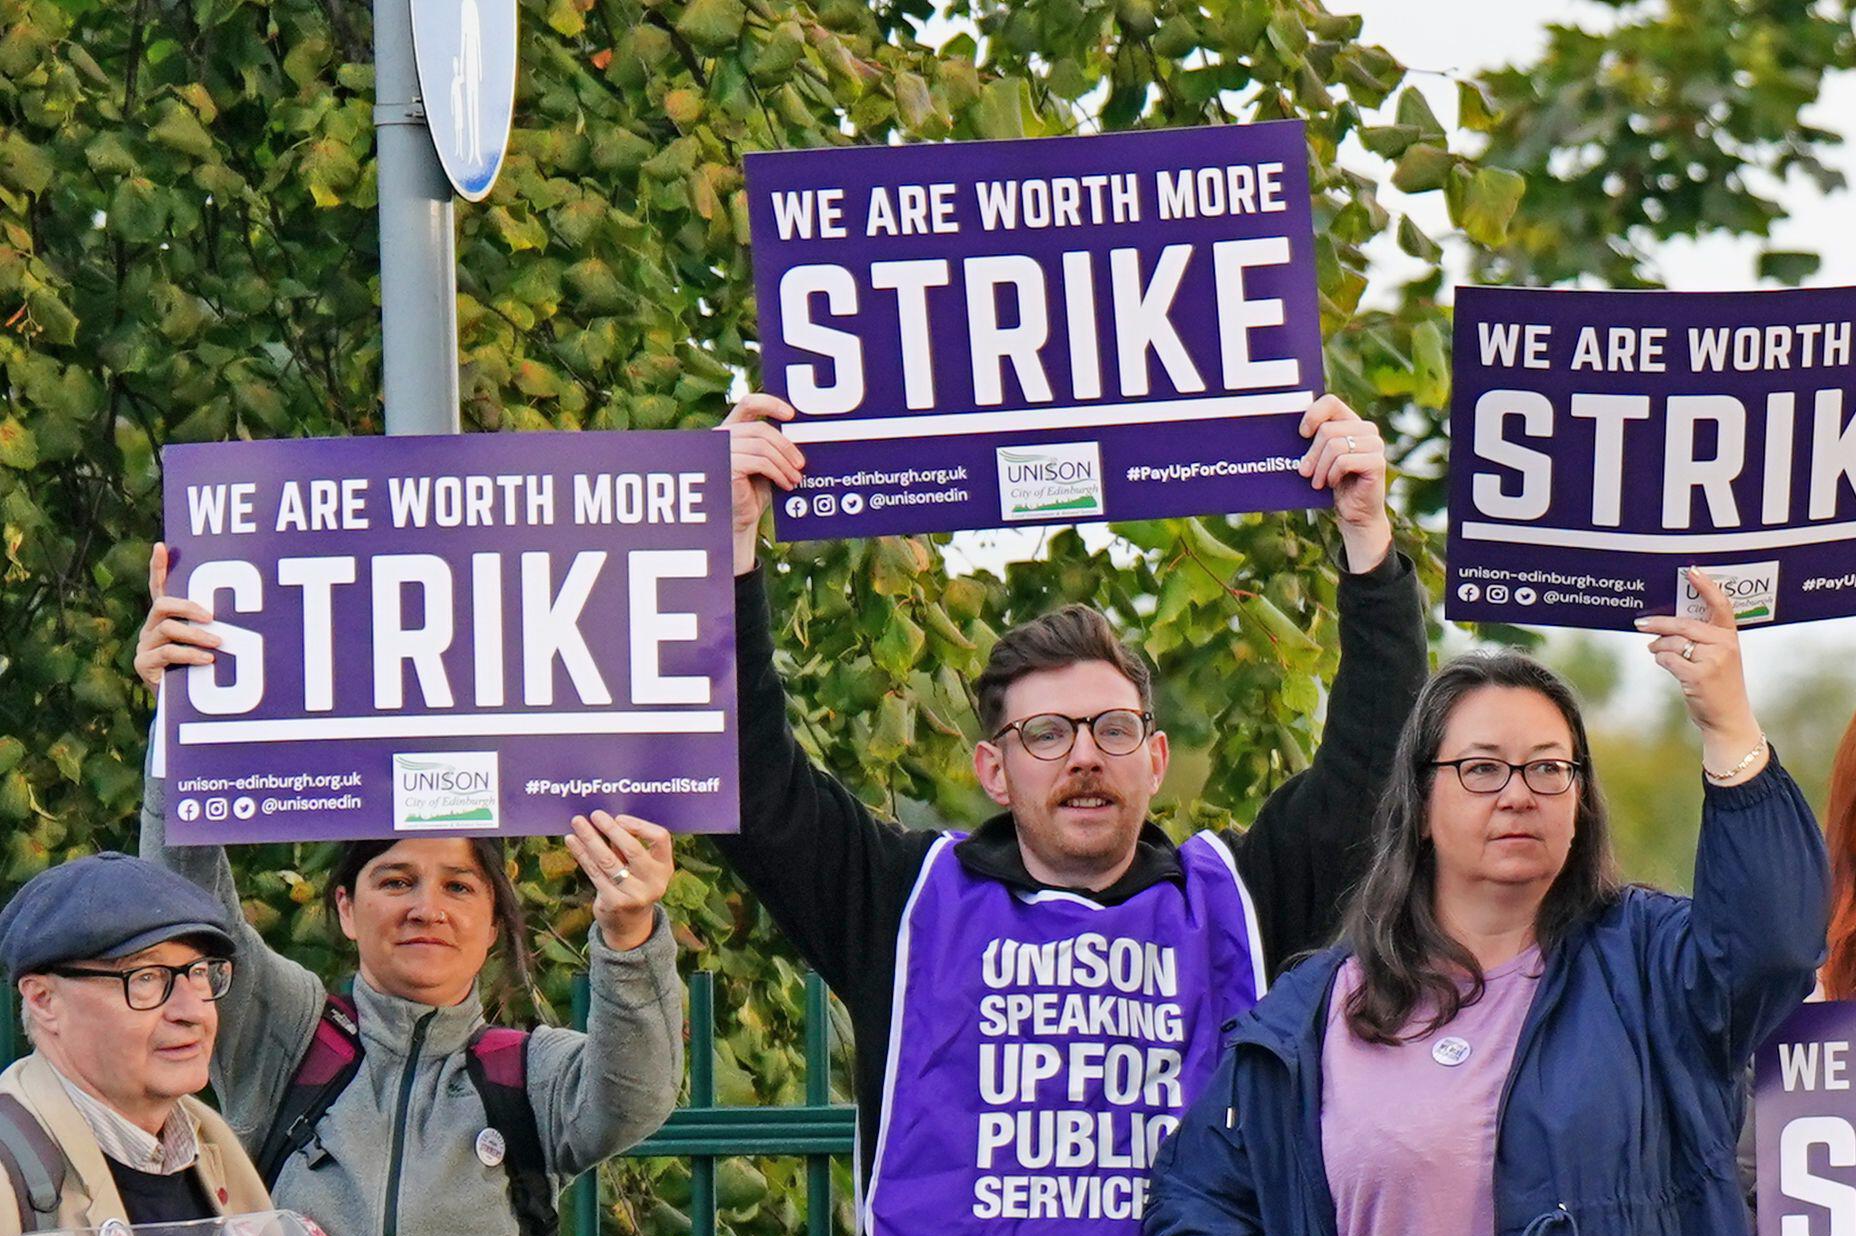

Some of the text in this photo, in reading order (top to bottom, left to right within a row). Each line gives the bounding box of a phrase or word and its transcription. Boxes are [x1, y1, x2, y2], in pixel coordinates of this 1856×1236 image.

[772, 162, 1286, 240] WE ARE WORTH MORE
[779, 236, 1300, 416] STRIKE
[1478, 323, 1551, 369] WE
[1571, 327, 1667, 373] ARE
[1688, 322, 1850, 373] WORTH
[794, 466, 967, 488] nison-edinburgh.org.uk
[1008, 461, 1090, 483] UNISON
[1127, 456, 1306, 482] #PayUpForCouncilSta
[869, 488, 968, 510] @unisonedin
[1047, 484, 1098, 497] Edinburgh
[187, 473, 708, 536] WE ARE WORTH MORE
[1458, 566, 1645, 592] unison-edinburgh.org.uk
[1543, 590, 1644, 609] @unisonedin
[187, 550, 711, 715] STRIKE
[178, 772, 362, 792] unison-edinburgh.org.uk
[403, 772, 489, 791] UNISON
[525, 777, 720, 797] #PayUpForCouncilStaff
[262, 795, 361, 815] @unisonedin
[982, 932, 1178, 997] UNISON
[979, 993, 1184, 1042] SPEAKING
[978, 1042, 1183, 1107] UP FOR
[1778, 1041, 1850, 1091] WE
